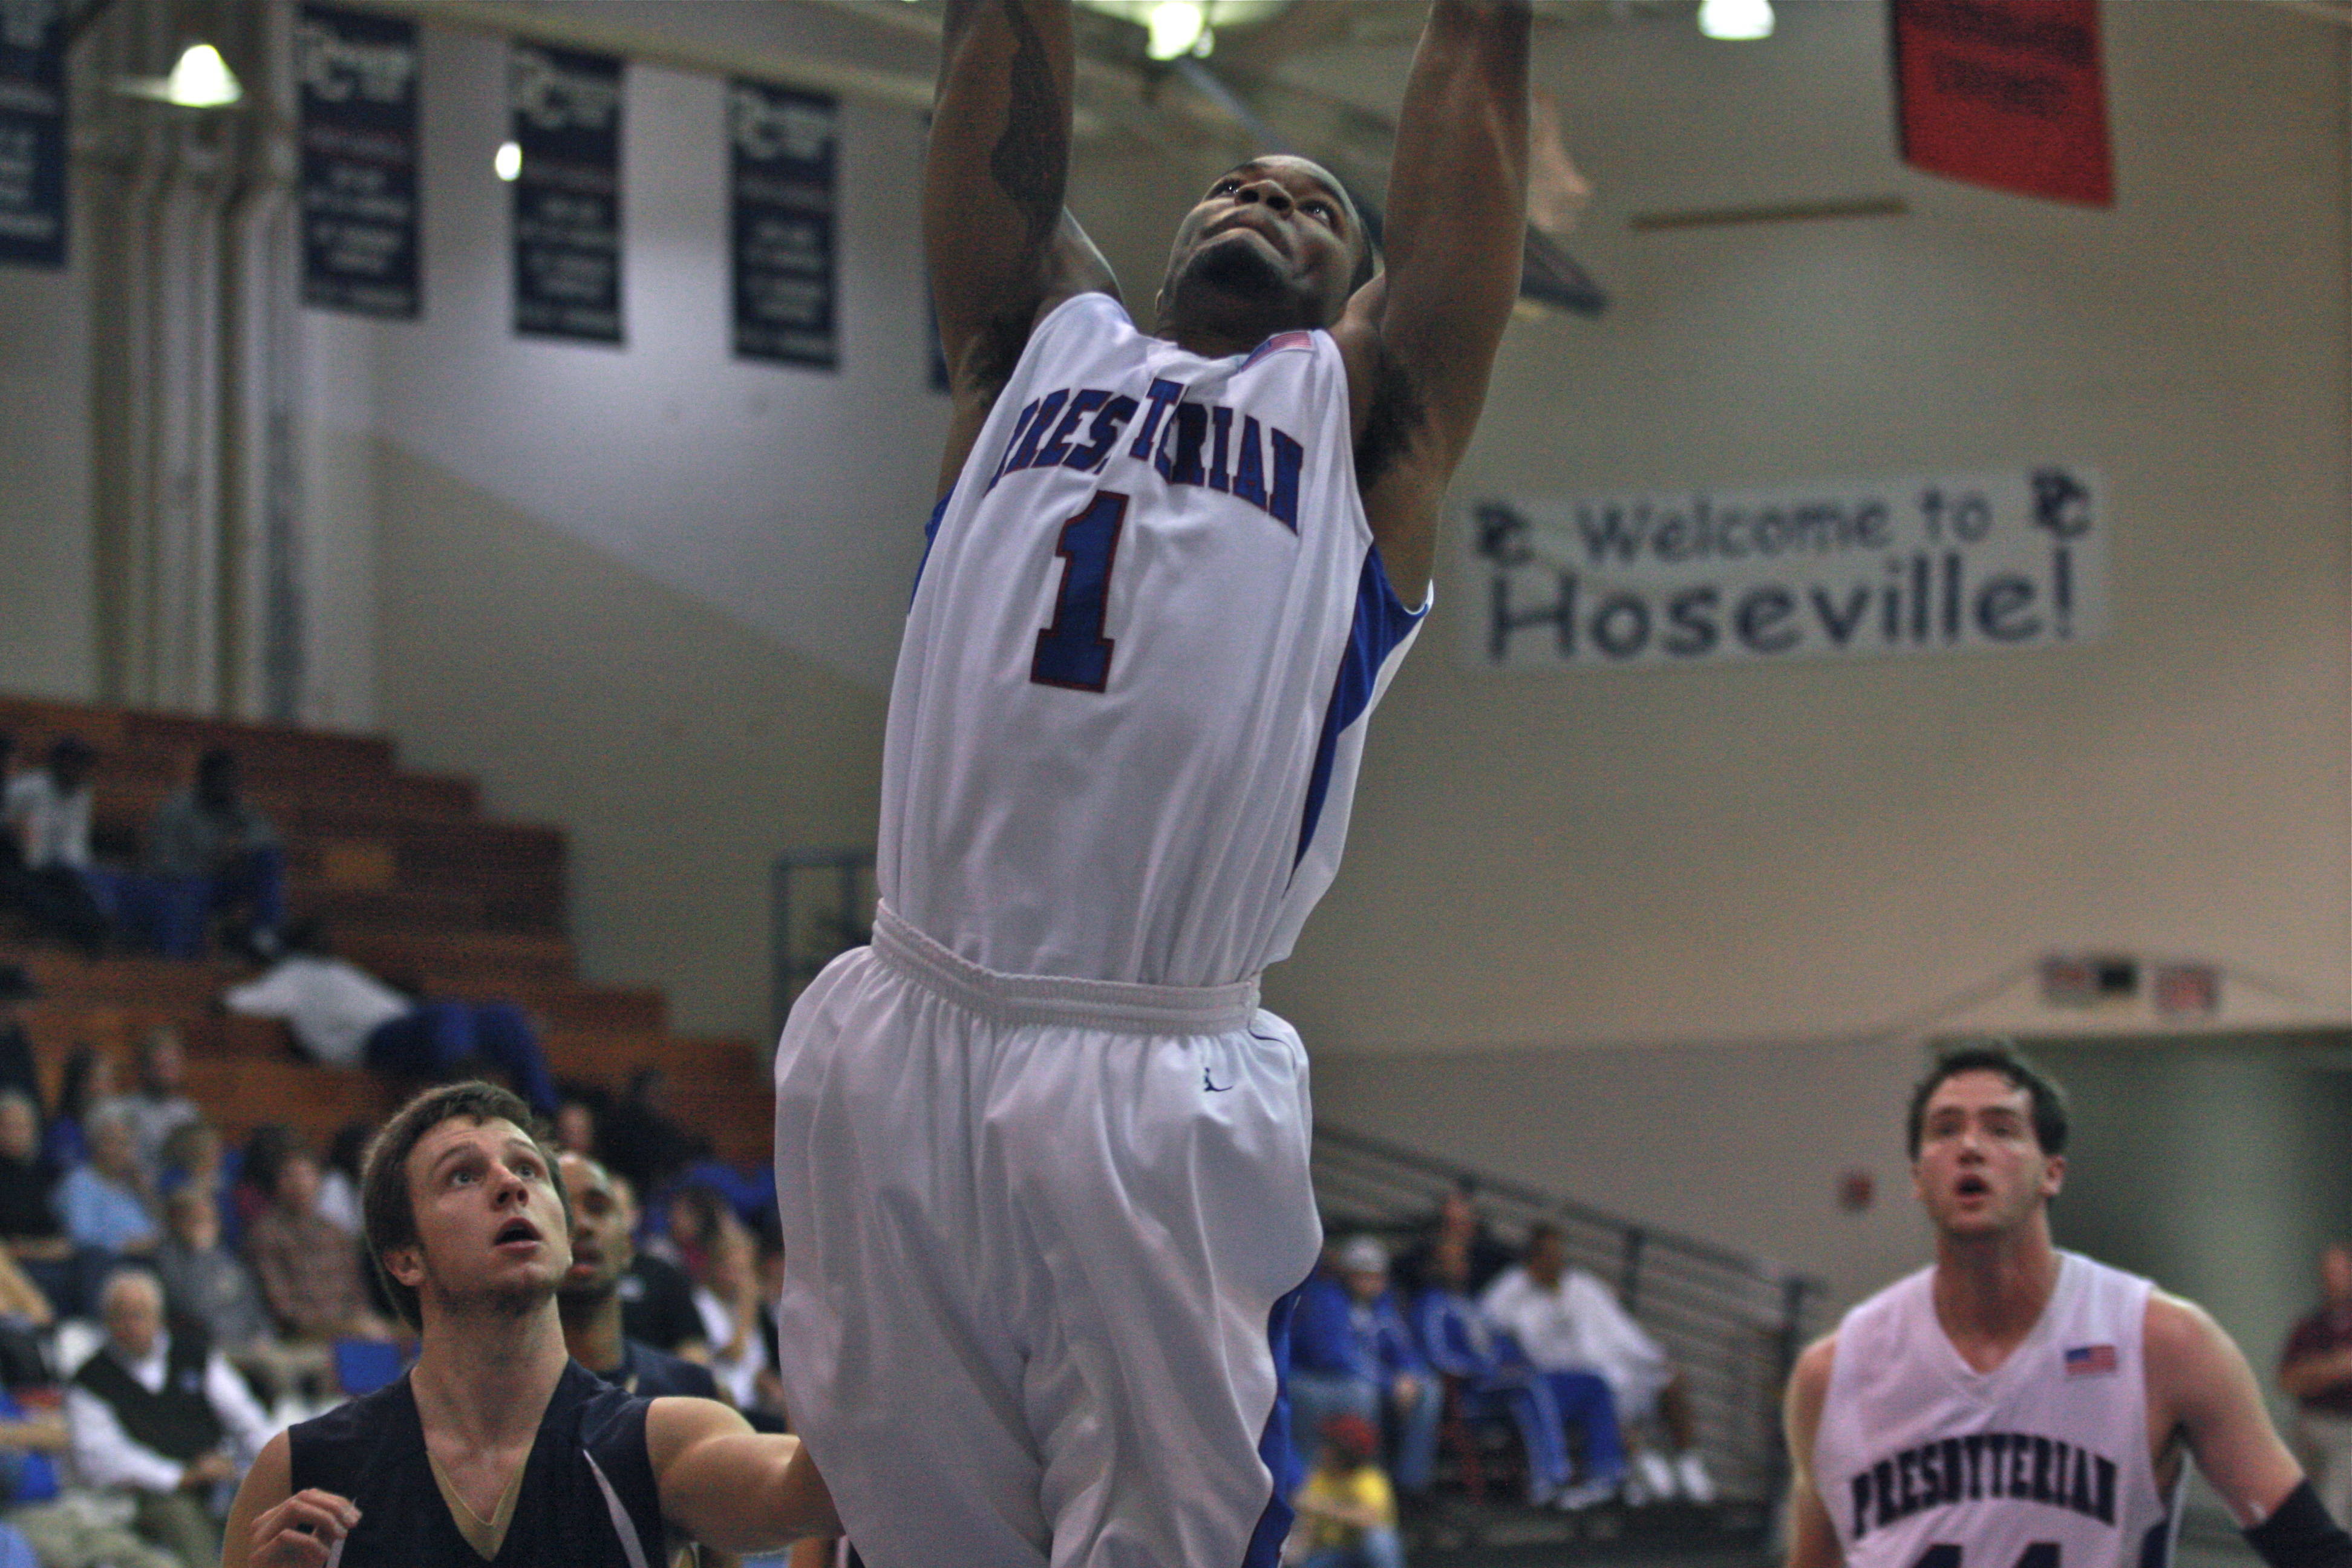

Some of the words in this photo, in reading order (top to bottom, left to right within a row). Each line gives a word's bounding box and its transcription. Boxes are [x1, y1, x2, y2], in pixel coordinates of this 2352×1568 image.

[1575, 496, 1892, 564] Welcome
[1918, 488, 1994, 544] to
[1030, 489, 1129, 694] 1
[1486, 547, 2074, 662] Hoseville!
[1851, 1431, 2117, 1540] PRESBYTERIAN
